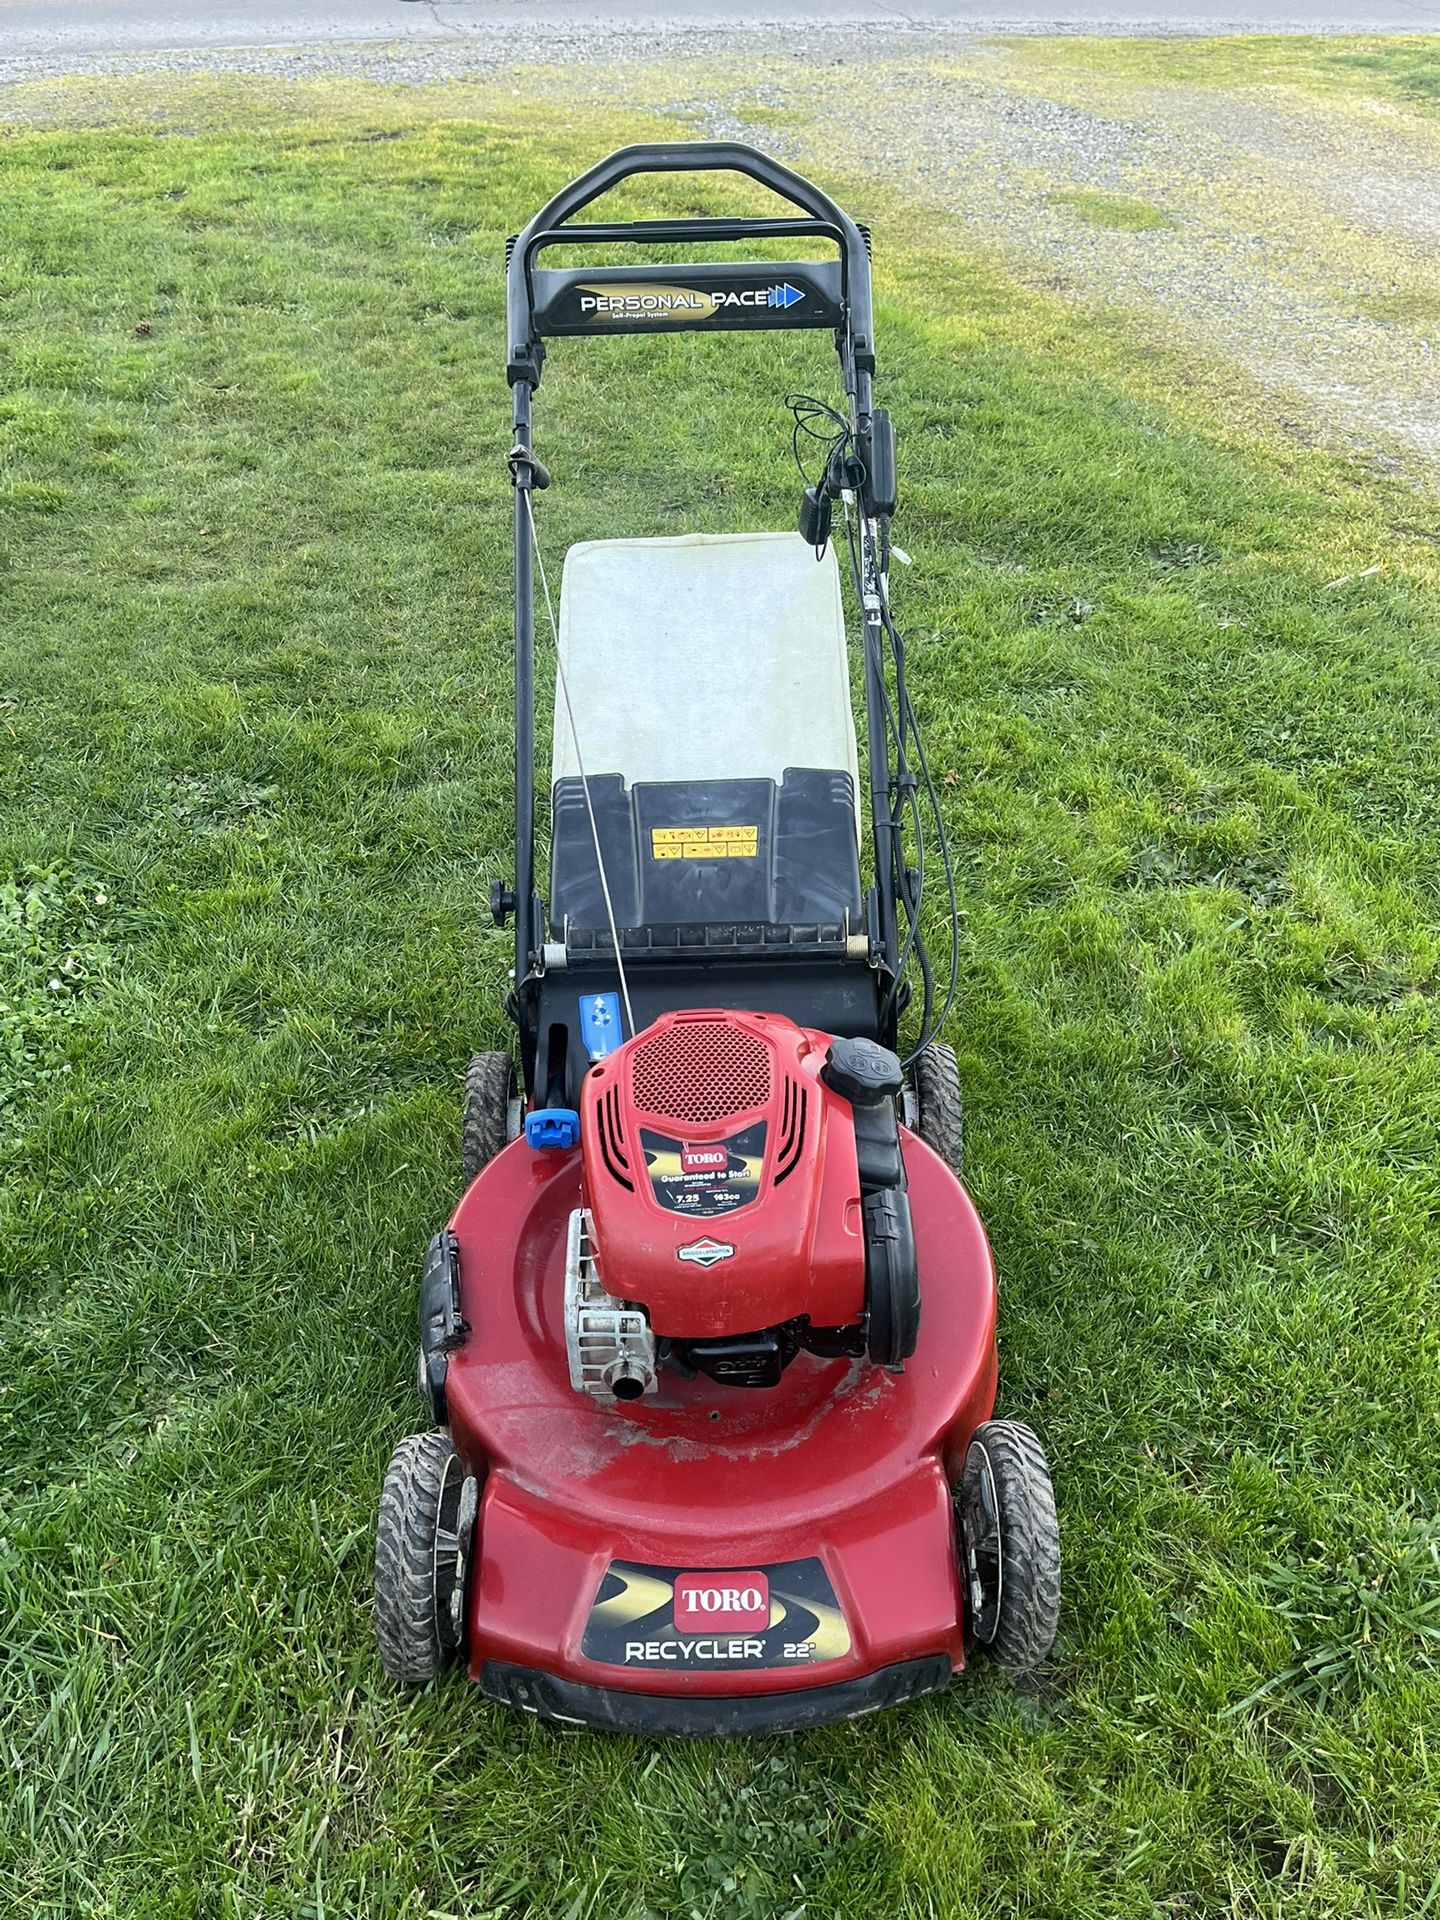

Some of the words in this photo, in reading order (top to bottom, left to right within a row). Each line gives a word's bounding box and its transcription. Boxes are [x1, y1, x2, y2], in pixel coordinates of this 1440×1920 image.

[581, 293, 703, 312] PERSONAL
[711, 290, 769, 307] PACE
[647, 311, 669, 319] System
[685, 1152, 725, 1165] TORO
[660, 1172, 715, 1183] Guaranteed
[717, 1171, 727, 1179] to
[728, 1170, 751, 1179] Start
[675, 1194, 700, 1204] 7.25
[682, 1588, 763, 1613] TORO
[624, 1640, 764, 1661] RECYCLER
